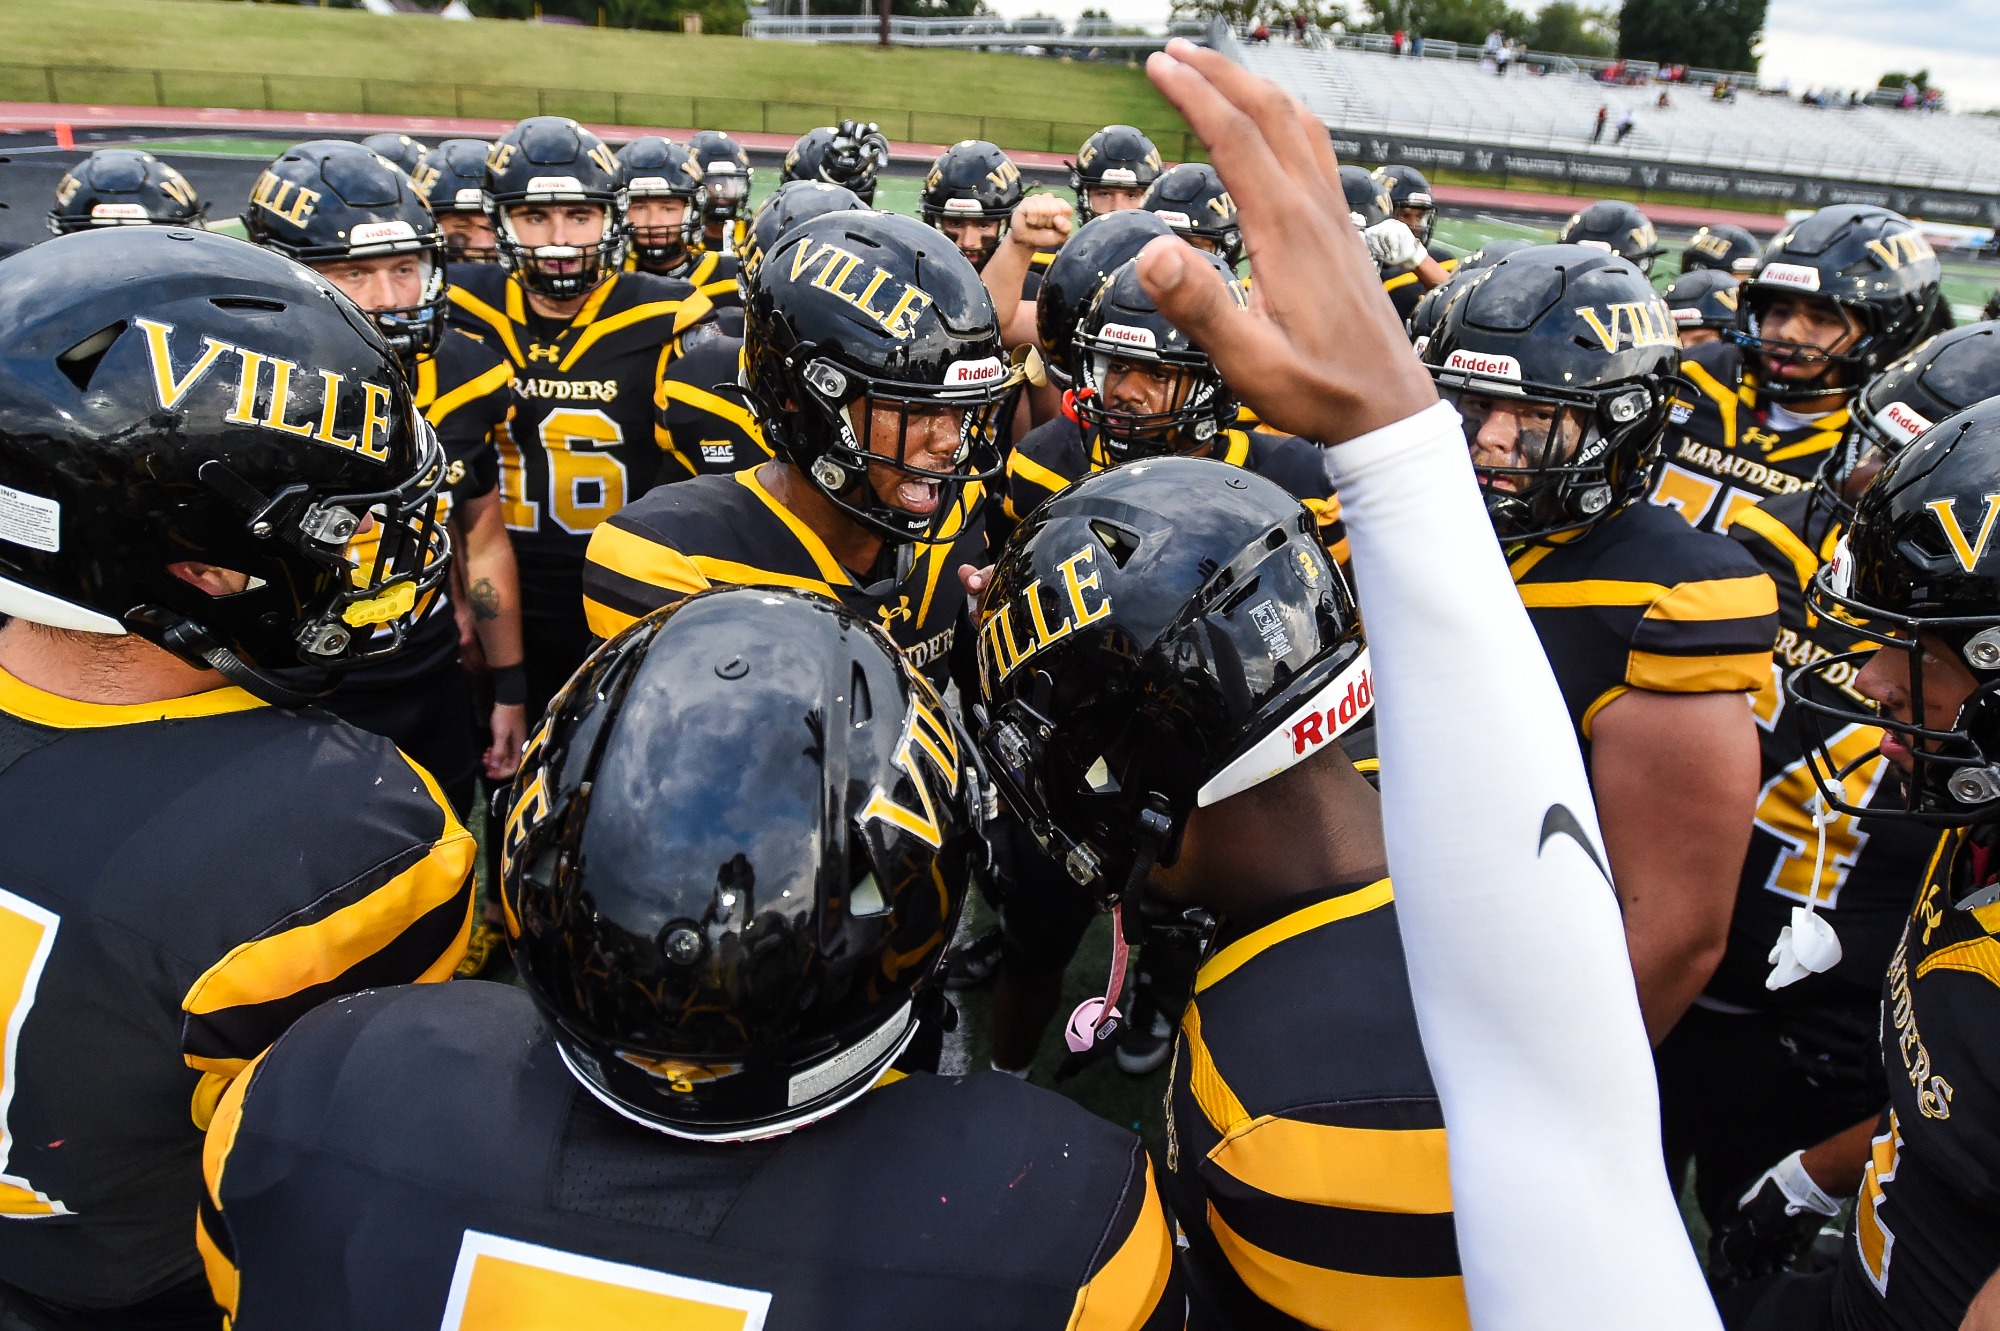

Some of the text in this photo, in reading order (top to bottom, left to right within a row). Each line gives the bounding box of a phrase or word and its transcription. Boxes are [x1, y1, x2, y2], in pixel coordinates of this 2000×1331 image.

[787, 237, 932, 340] VILLE
[1105, 327, 1147, 344] Riddell
[133, 316, 392, 464] VILLE
[958, 364, 1000, 381] Riddell
[495, 407, 628, 535] 16
[701, 445, 735, 457] PSAC
[1298, 551, 1319, 580] 2
[1292, 668, 1375, 755] Ridd
